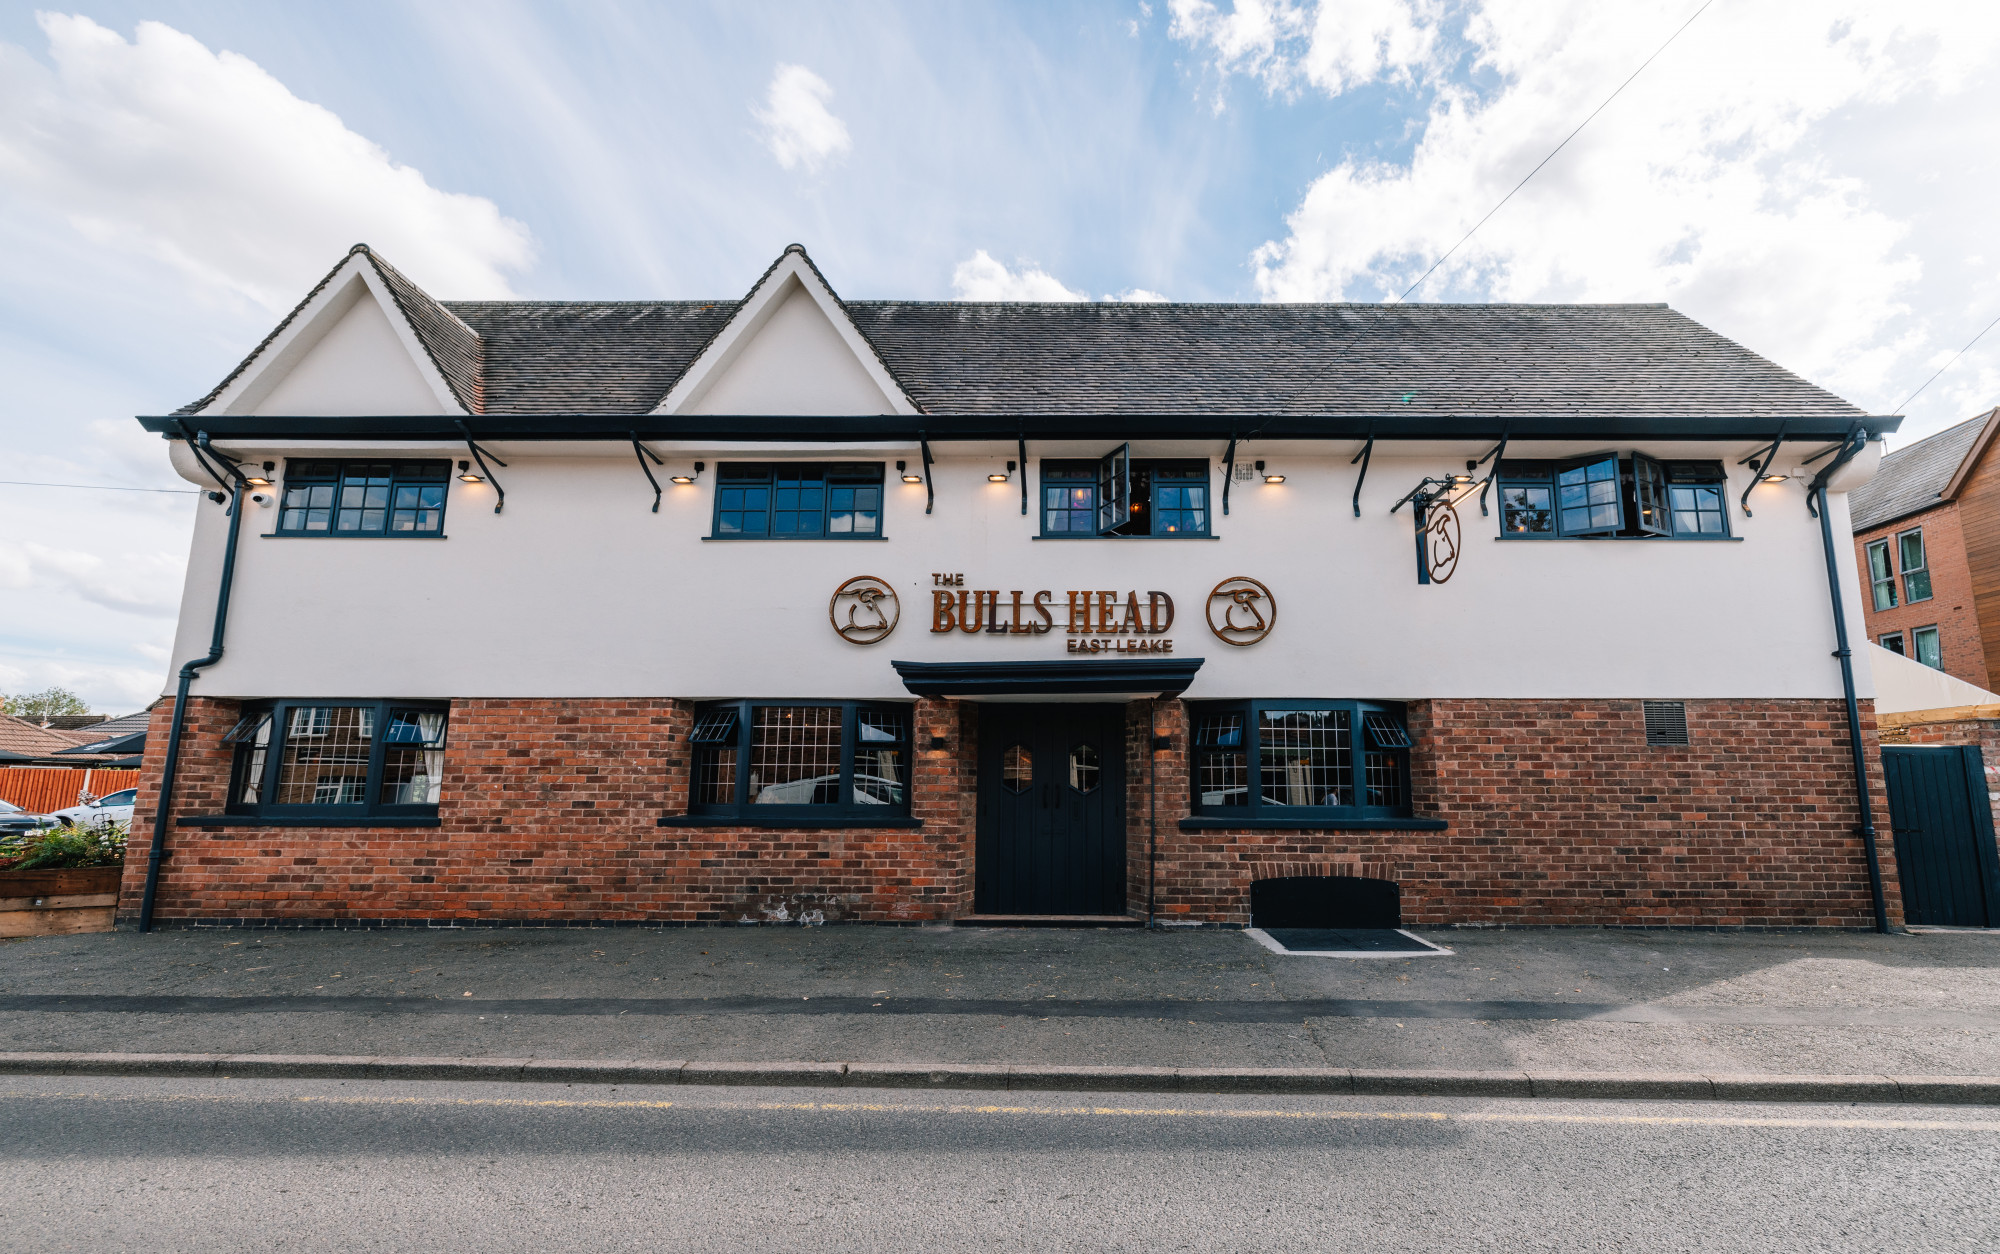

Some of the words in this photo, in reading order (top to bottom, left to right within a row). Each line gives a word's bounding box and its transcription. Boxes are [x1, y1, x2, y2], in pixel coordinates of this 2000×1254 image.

[932, 573, 964, 586] THE
[930, 590, 1053, 633] BULLS
[1066, 590, 1175, 634] HEAD
[1067, 639, 1112, 653] EAST
[1116, 639, 1173, 653] LEAKE
